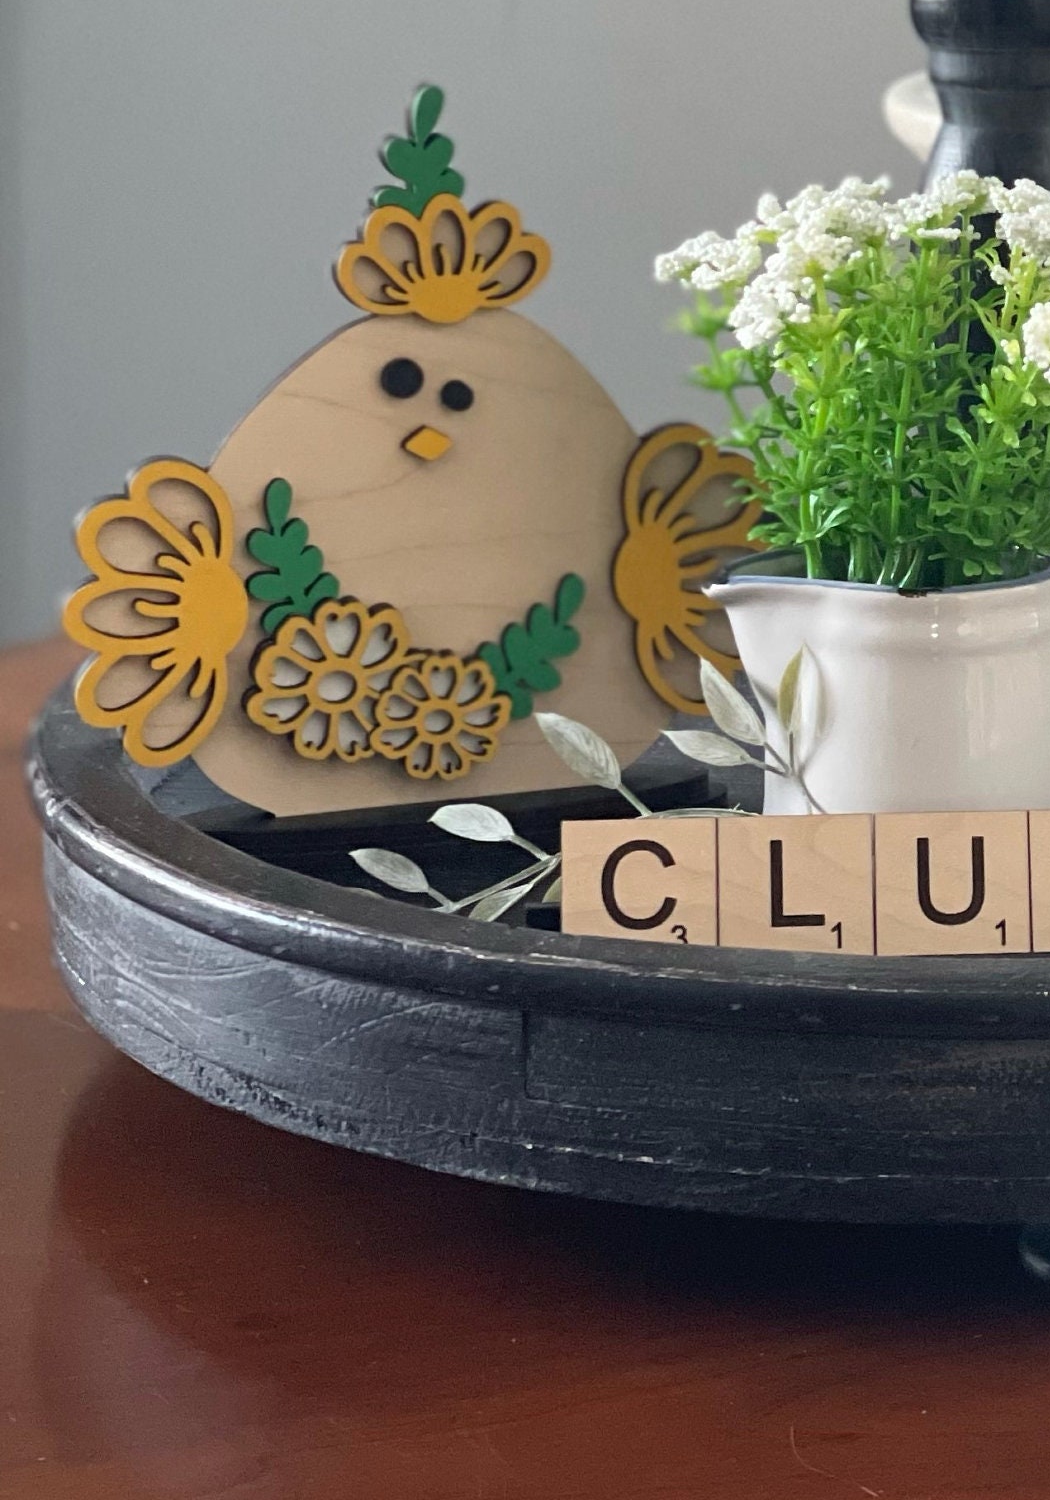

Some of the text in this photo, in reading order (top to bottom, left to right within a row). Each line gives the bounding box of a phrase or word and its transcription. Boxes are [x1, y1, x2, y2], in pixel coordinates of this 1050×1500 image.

[670, 924, 689, 945] 3
[830, 921, 842, 949] 1
[995, 919, 1007, 946] 1
